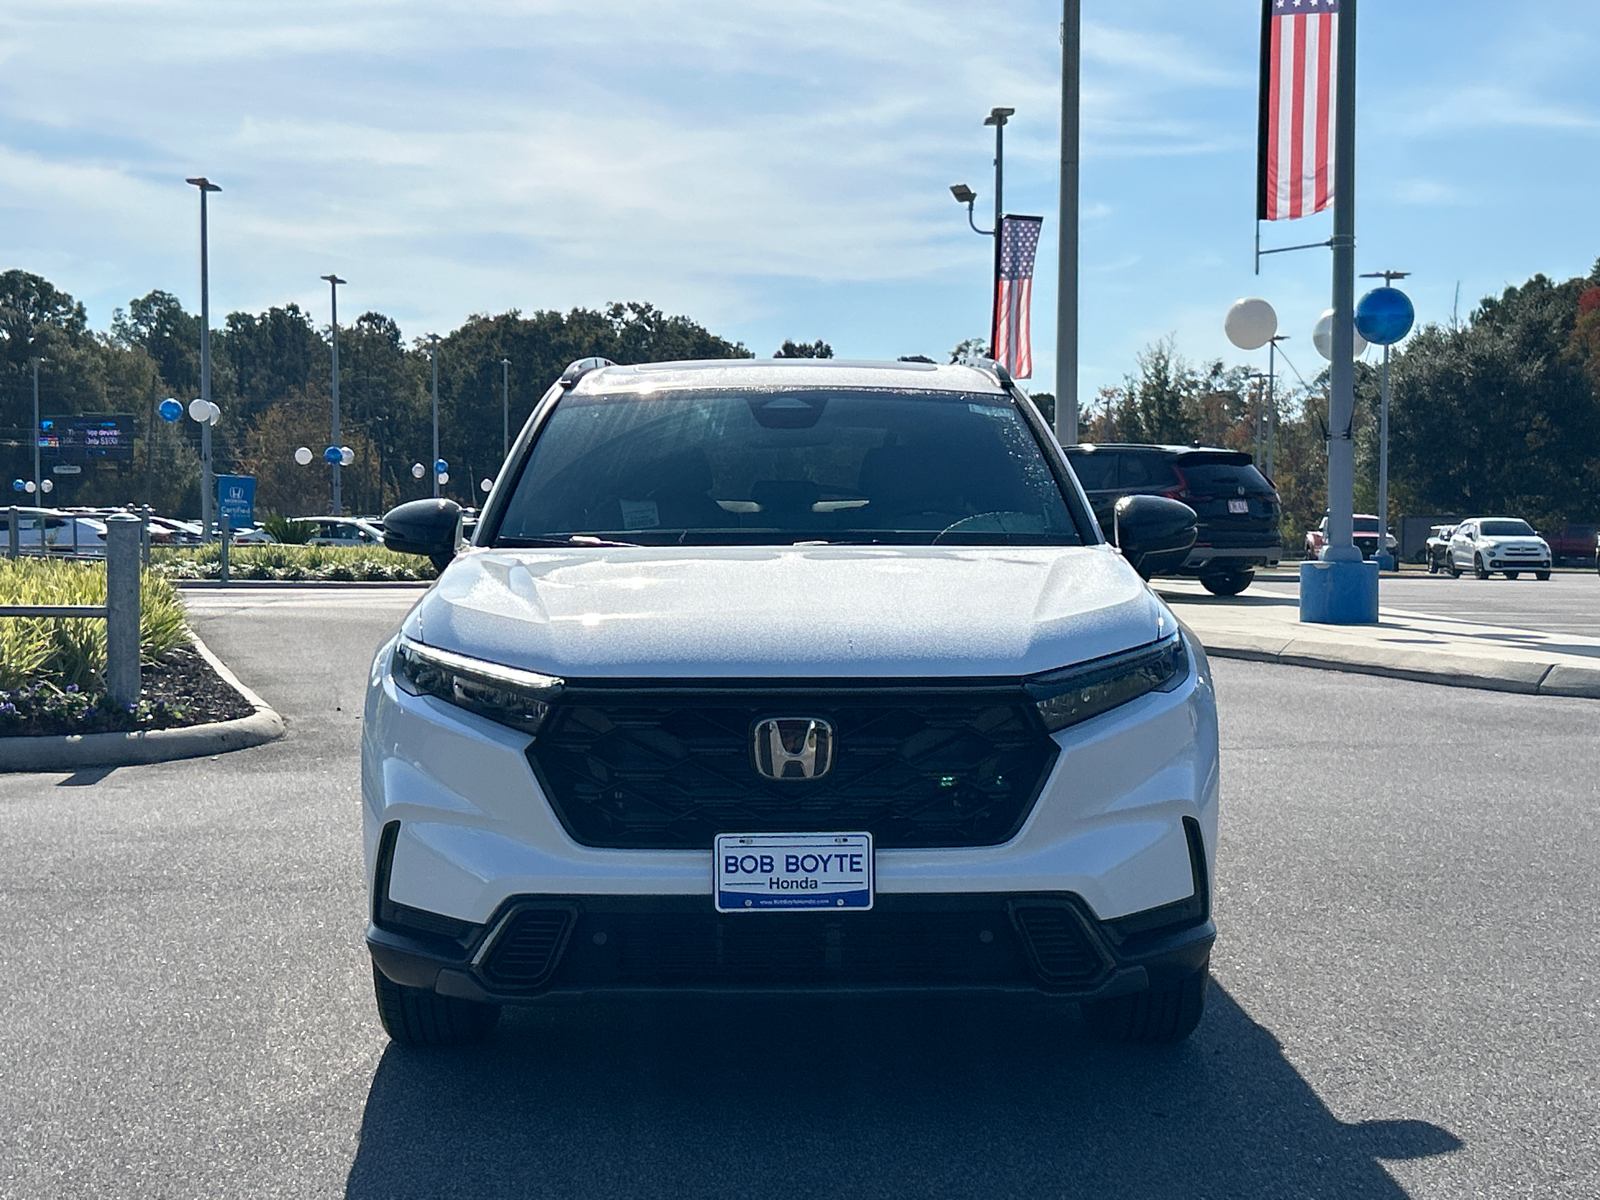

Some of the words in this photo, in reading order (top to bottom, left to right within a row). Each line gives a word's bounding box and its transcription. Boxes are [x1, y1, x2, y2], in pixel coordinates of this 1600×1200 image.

[724, 854, 775, 874] BOB
[785, 853, 863, 873] BOYTE
[769, 876, 818, 890] Honda
